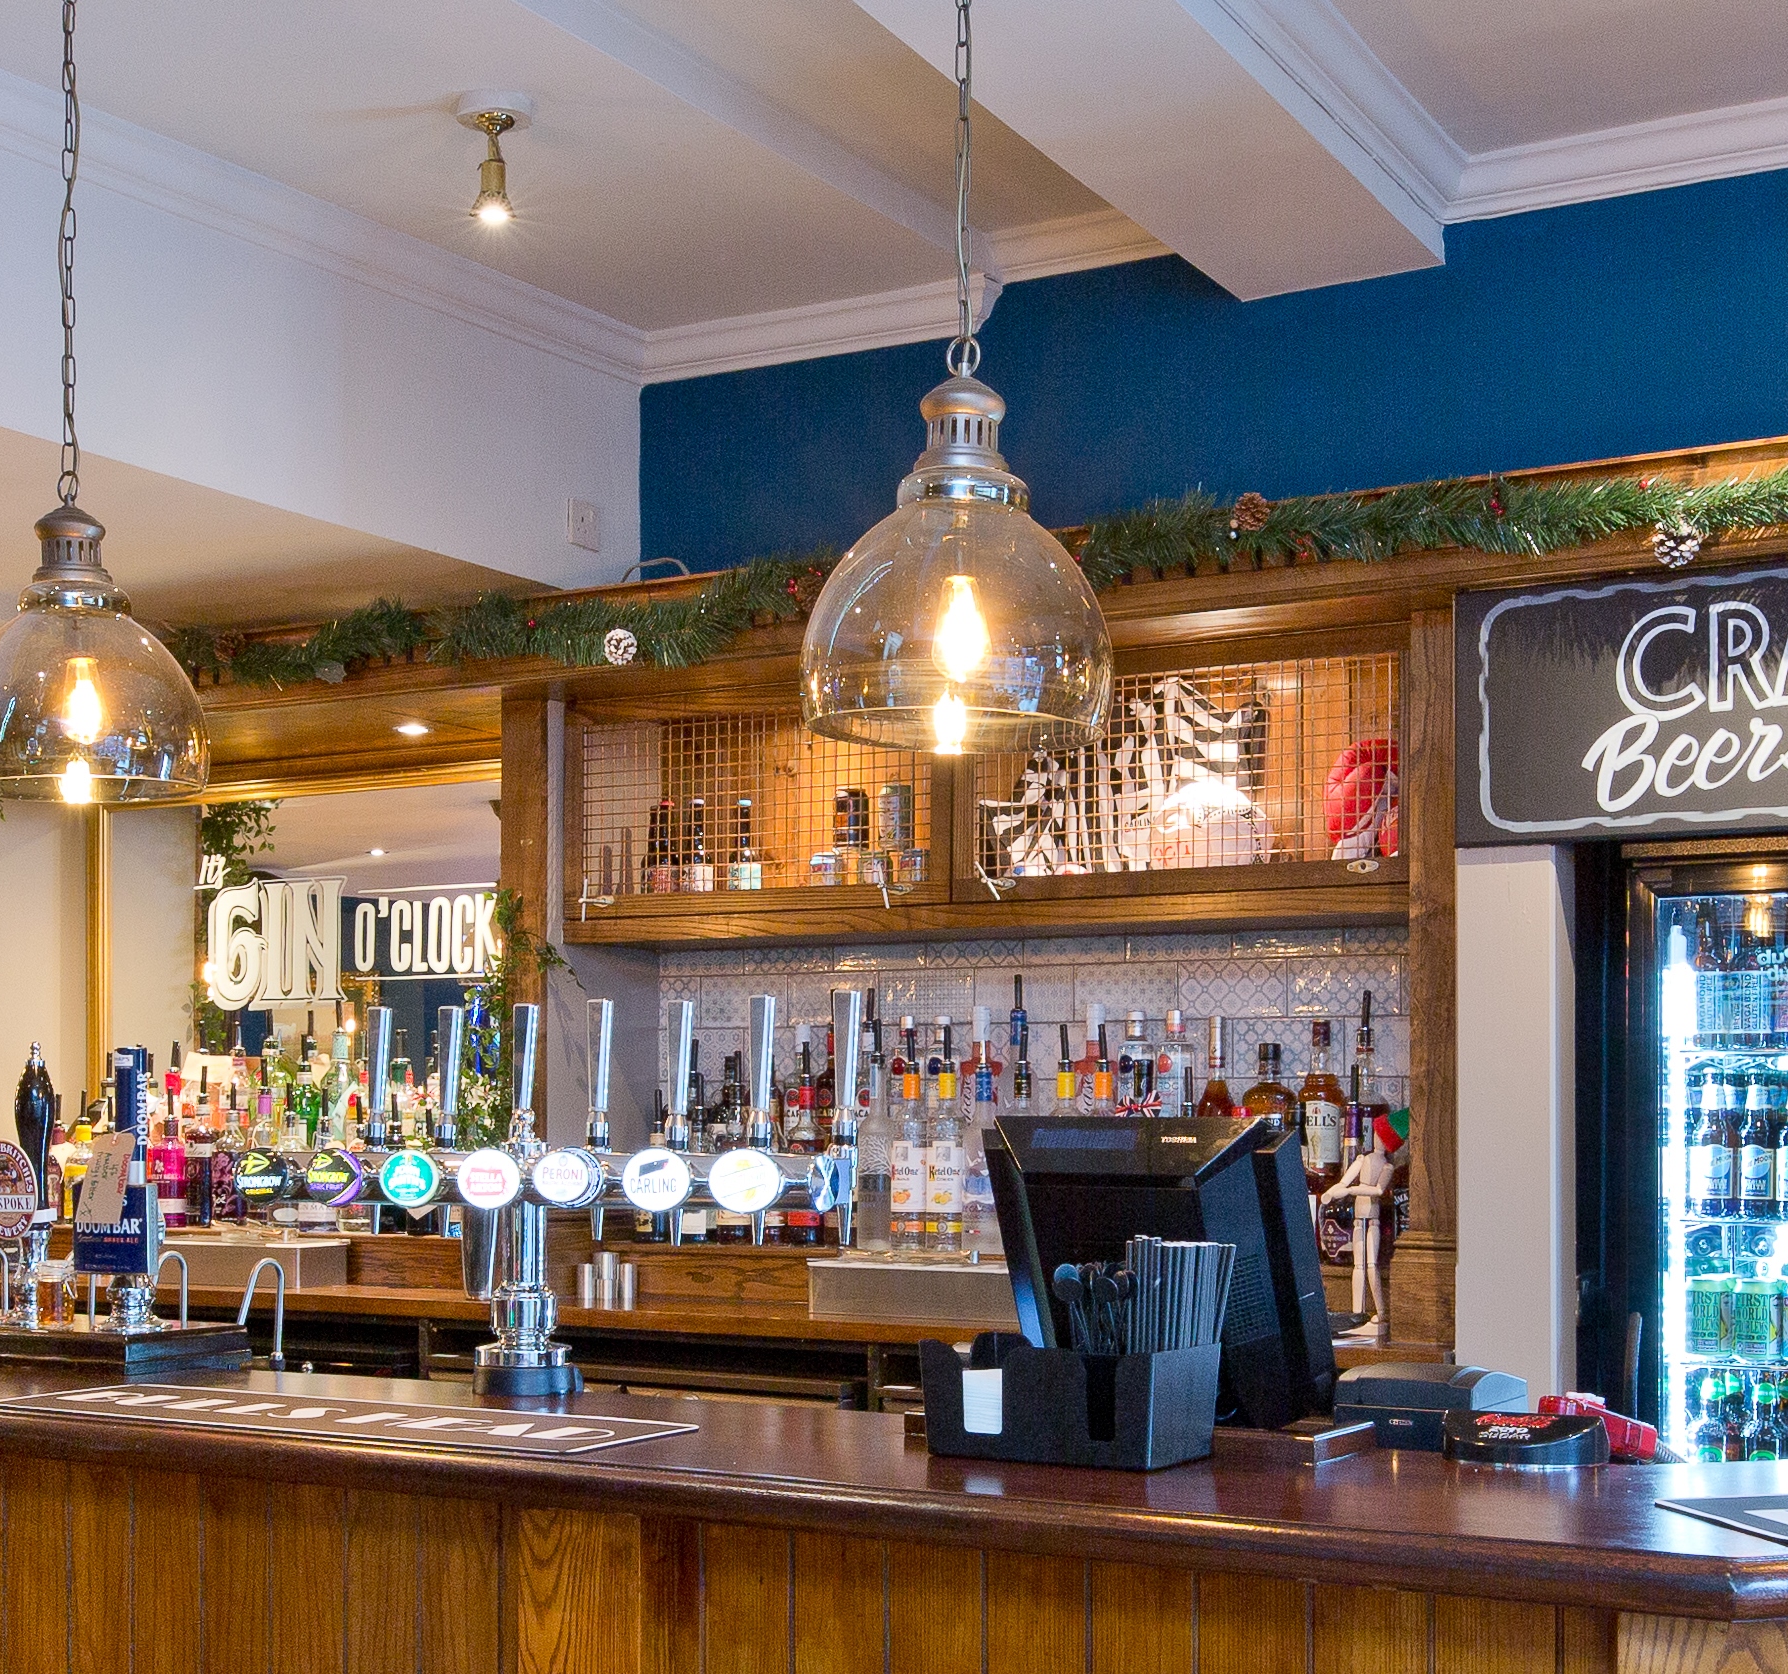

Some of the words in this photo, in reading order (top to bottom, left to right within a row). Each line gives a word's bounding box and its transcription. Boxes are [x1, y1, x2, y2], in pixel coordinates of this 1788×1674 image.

[207, 875, 348, 1012] GIN
[354, 892, 499, 974] O'CLOCK
[1699, 974, 1707, 1030] VAGABOND
[1743, 974, 1752, 1030] VAGABOND
[136, 1072, 148, 1101] BAR
[136, 1102, 148, 1146] DOOM
[1306, 1112, 1337, 1128] ELL'S
[1161, 1136, 1198, 1145] TOSHIBA
[236, 1173, 283, 1190] STRONGBOW
[307, 1169, 351, 1186] STRONGBOW
[542, 1166, 584, 1181] PERONI
[929, 1164, 946, 1182] Ketel
[629, 1177, 678, 1194] CARLING
[76, 1221, 111, 1234] DOOM
[112, 1217, 142, 1235] BAR
[1693, 1292, 1720, 1306] IRST
[1736, 1294, 1768, 1307] FIRST
[1693, 1306, 1719, 1318] ORLD
[1736, 1307, 1768, 1320] WORLD
[55, 1390, 348, 1419] BULLS
[334, 1411, 615, 1441] HEAD
[1478, 1431, 1532, 1441] SUGAR
